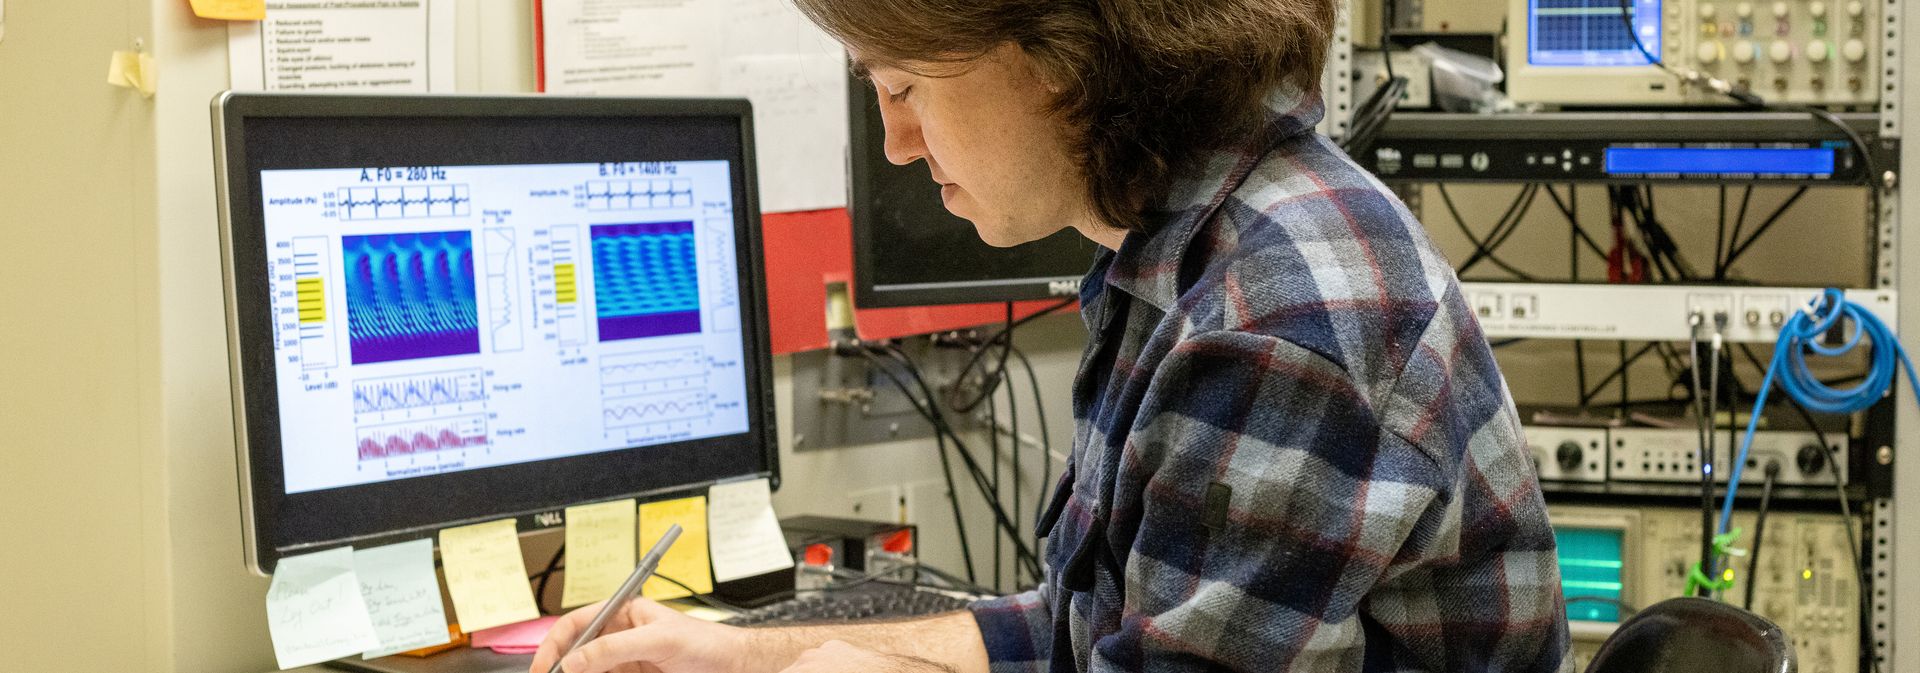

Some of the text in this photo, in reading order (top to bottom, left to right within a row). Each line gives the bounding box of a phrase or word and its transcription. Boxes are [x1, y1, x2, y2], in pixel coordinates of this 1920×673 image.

[360, 167, 374, 182] A.
[377, 167, 392, 182] F0
[407, 166, 428, 181] 280
[431, 166, 447, 181] Hz
[269, 197, 303, 206] Amplitude
[305, 383, 323, 392] Level
